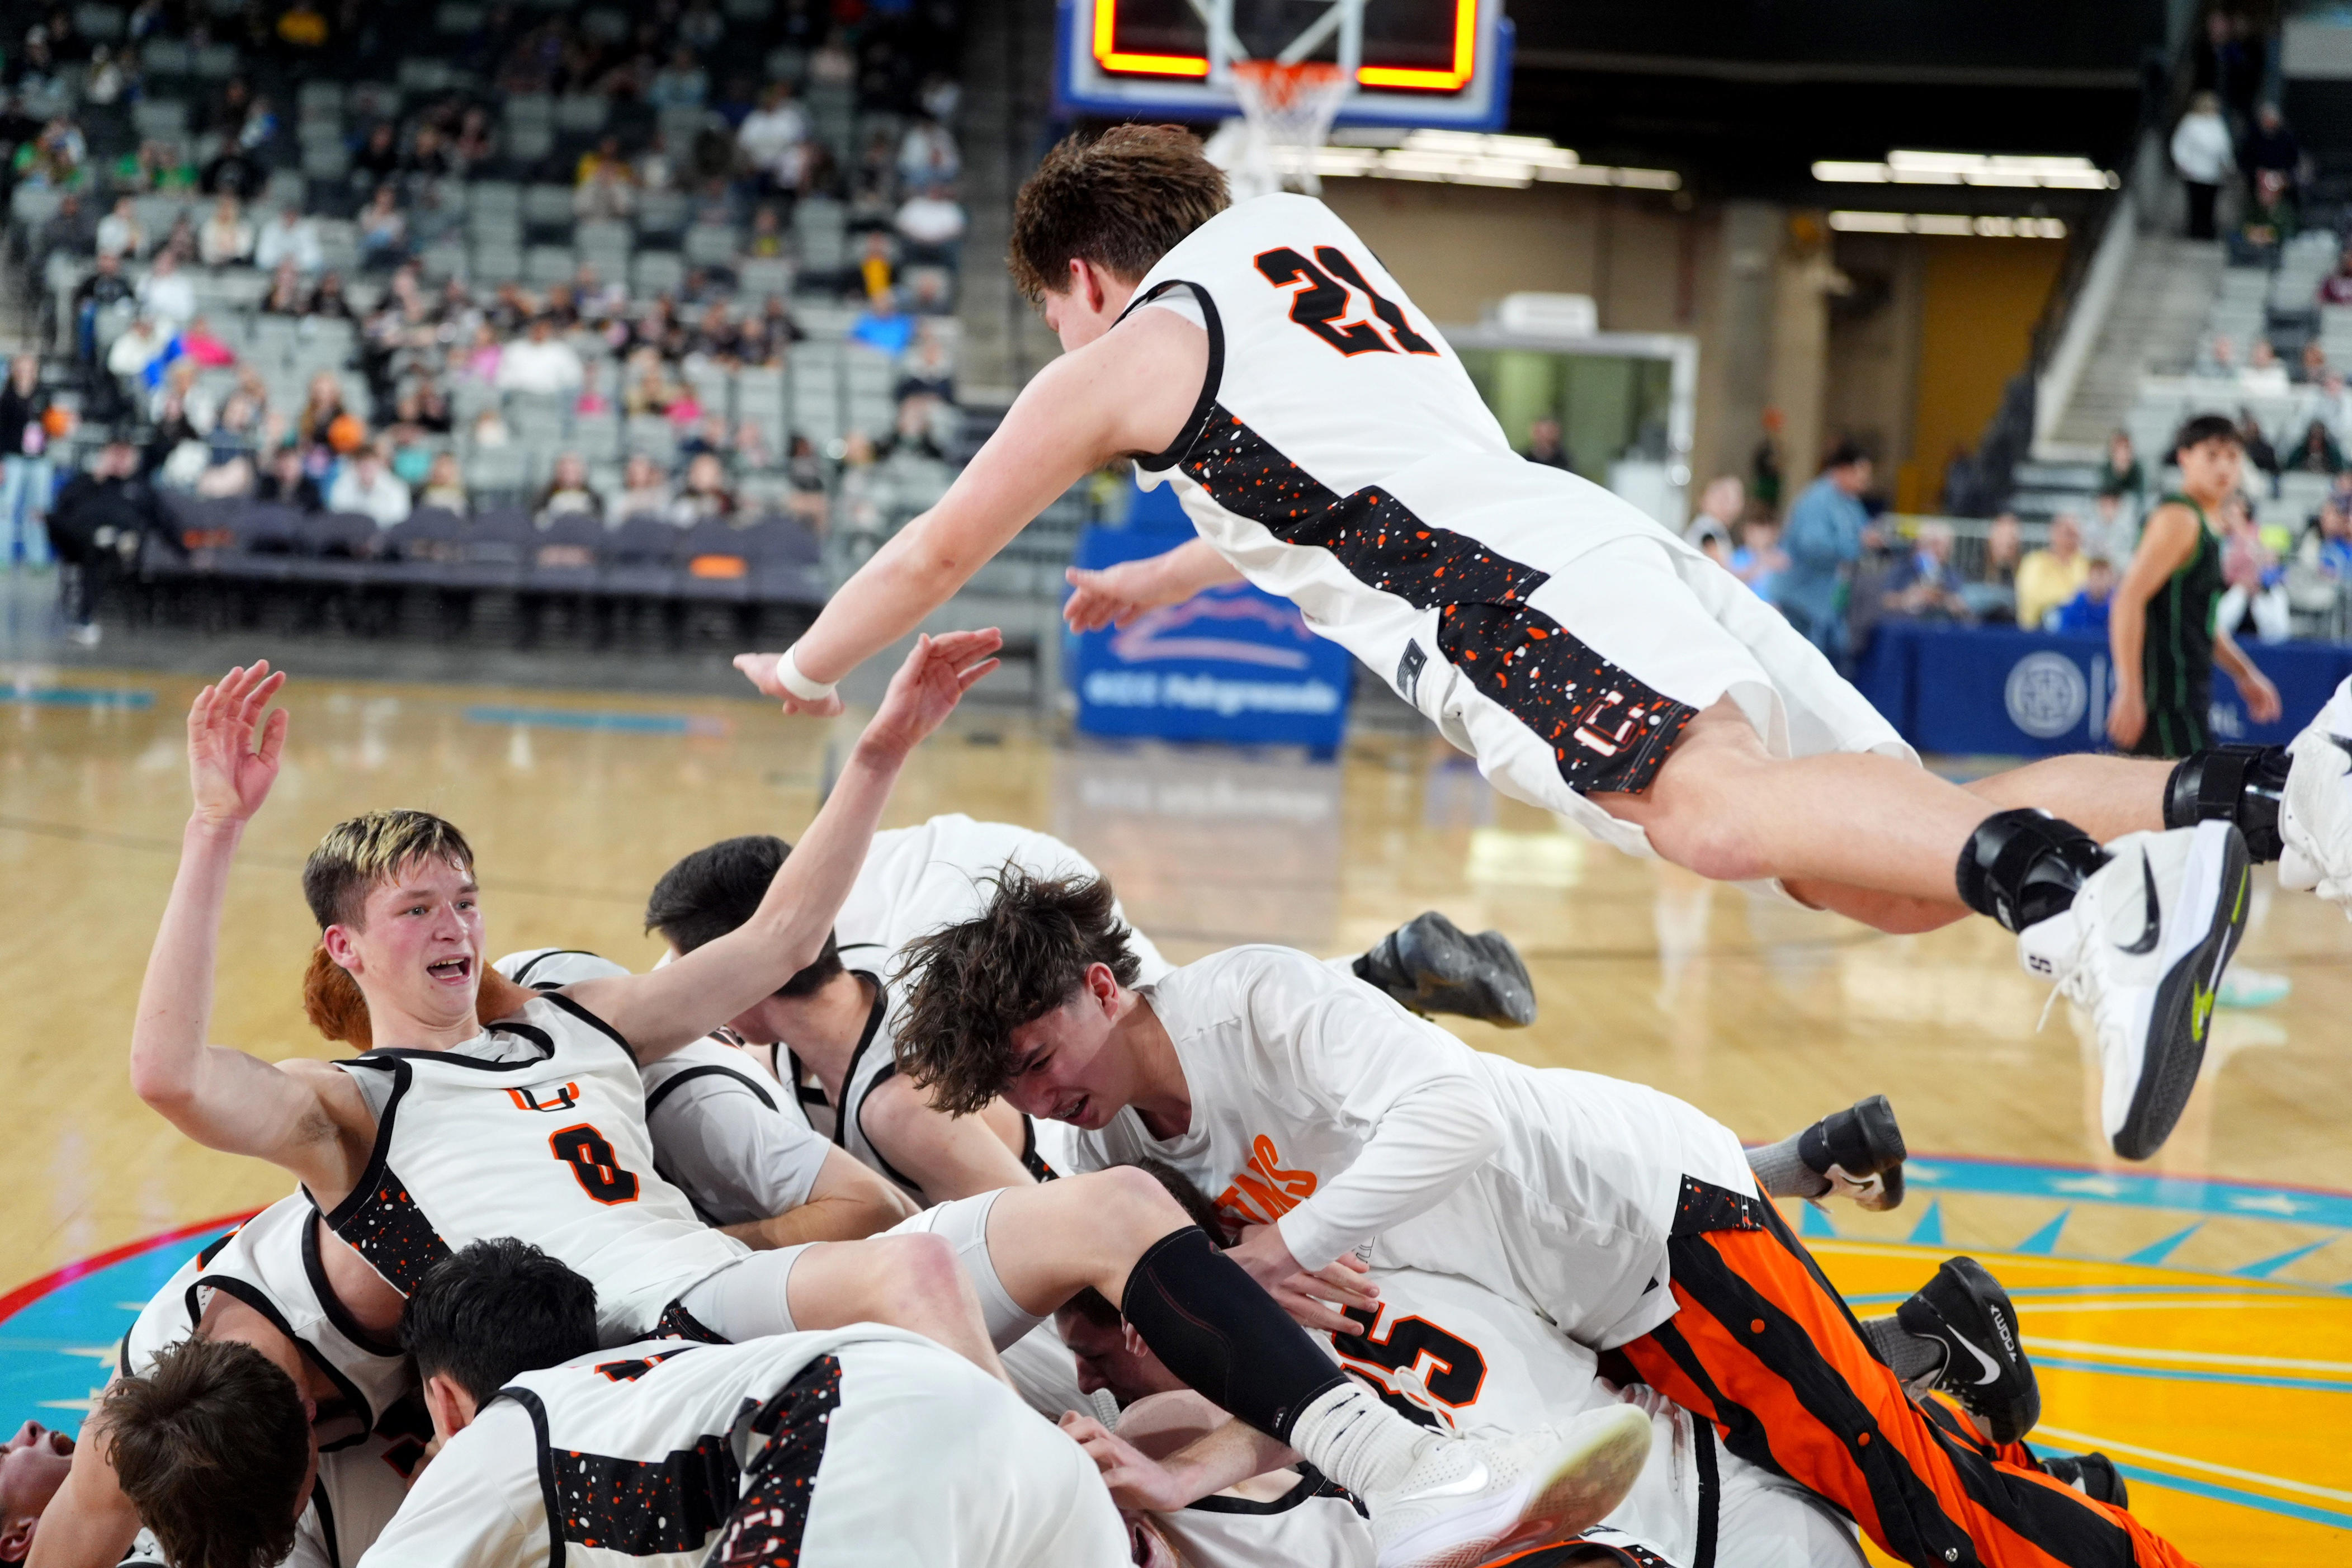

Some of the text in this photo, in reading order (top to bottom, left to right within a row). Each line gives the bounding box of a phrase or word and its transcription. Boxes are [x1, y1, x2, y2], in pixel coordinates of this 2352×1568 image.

[1254, 245, 1441, 357] 21
[548, 1122, 640, 1206] 0
[1332, 1298, 1488, 1430] 5
